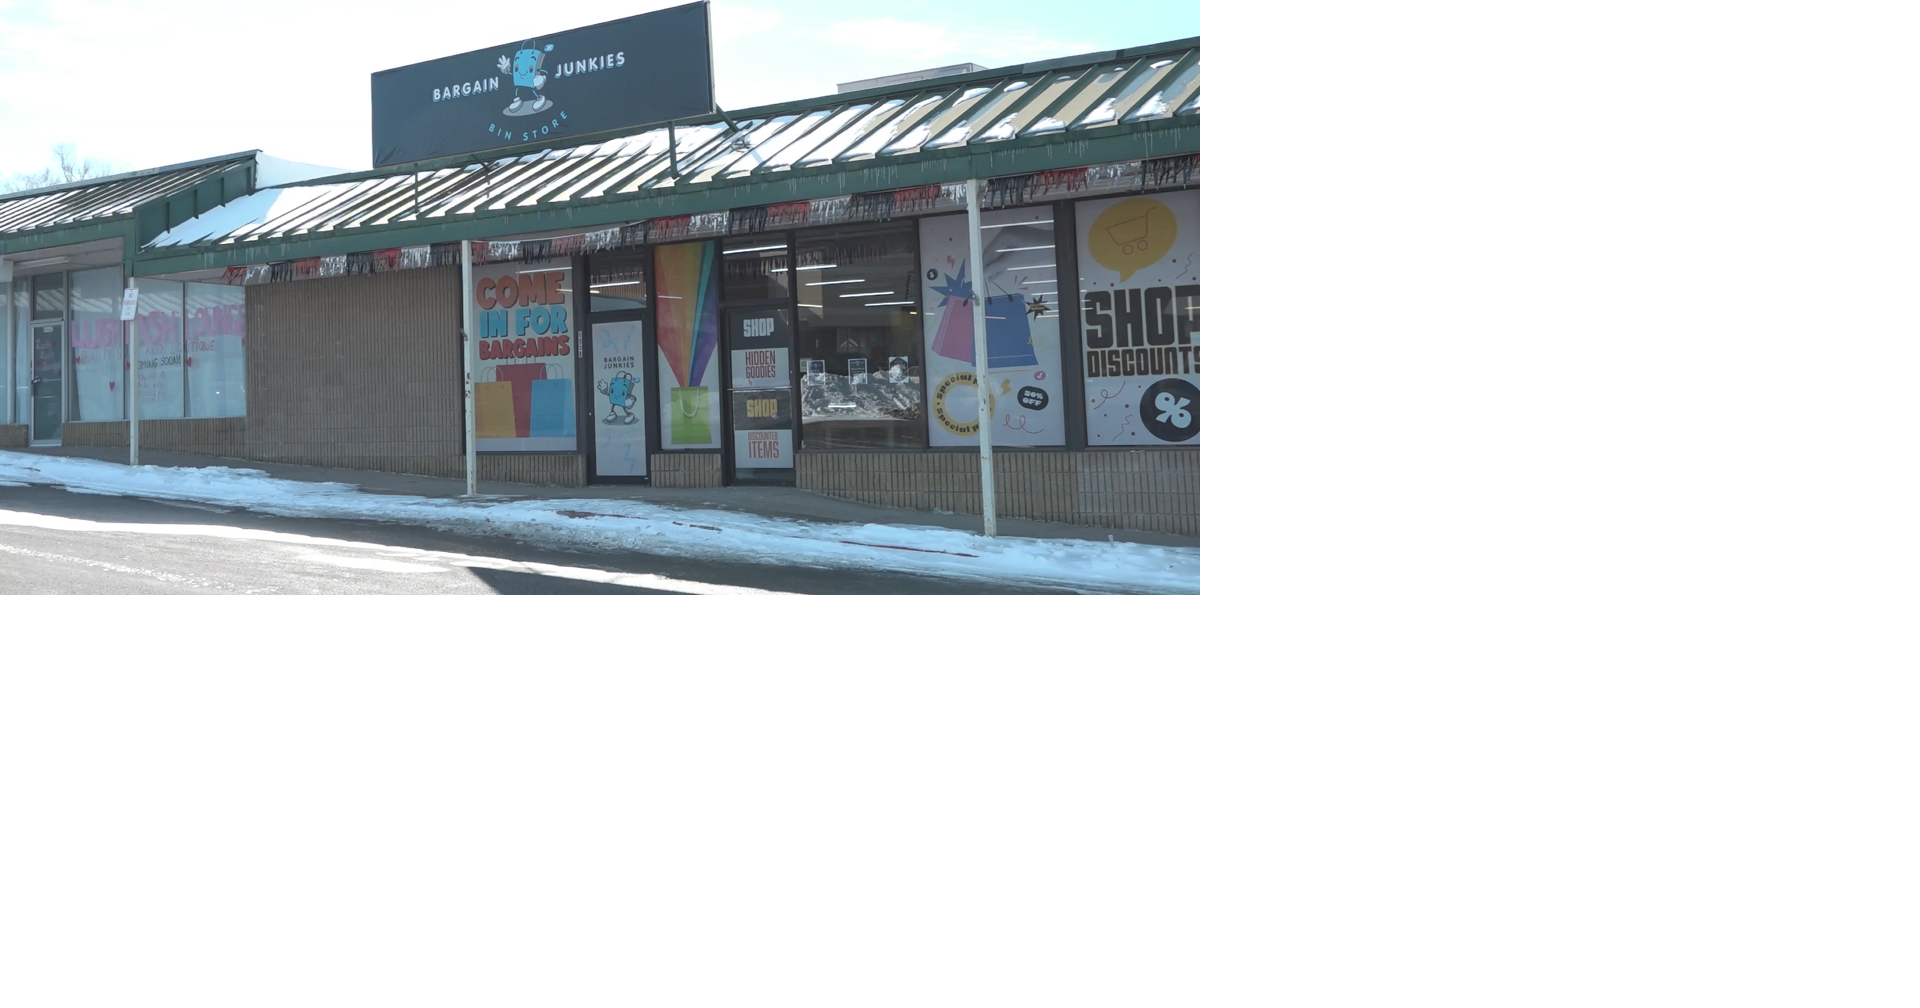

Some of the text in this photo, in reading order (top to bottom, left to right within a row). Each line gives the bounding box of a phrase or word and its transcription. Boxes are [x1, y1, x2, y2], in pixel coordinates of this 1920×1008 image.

[433, 52, 626, 102] BARGAIN JUNKIES
[488, 110, 568, 141] BIN STORE
[476, 271, 566, 311] COME
[480, 304, 568, 338] IN FOR
[1085, 284, 1200, 349] SHOP
[743, 318, 775, 337] SHOP
[478, 335, 571, 360] BARGAINS
[137, 357, 158, 370] OMING
[745, 350, 776, 366] HIDDEN
[746, 365, 776, 379] GOODIES
[747, 399, 778, 418] SHOP
[1022, 397, 1042, 406] OFF
[748, 431, 778, 440] DISCOUNTED
[748, 441, 780, 459] ITEMS
